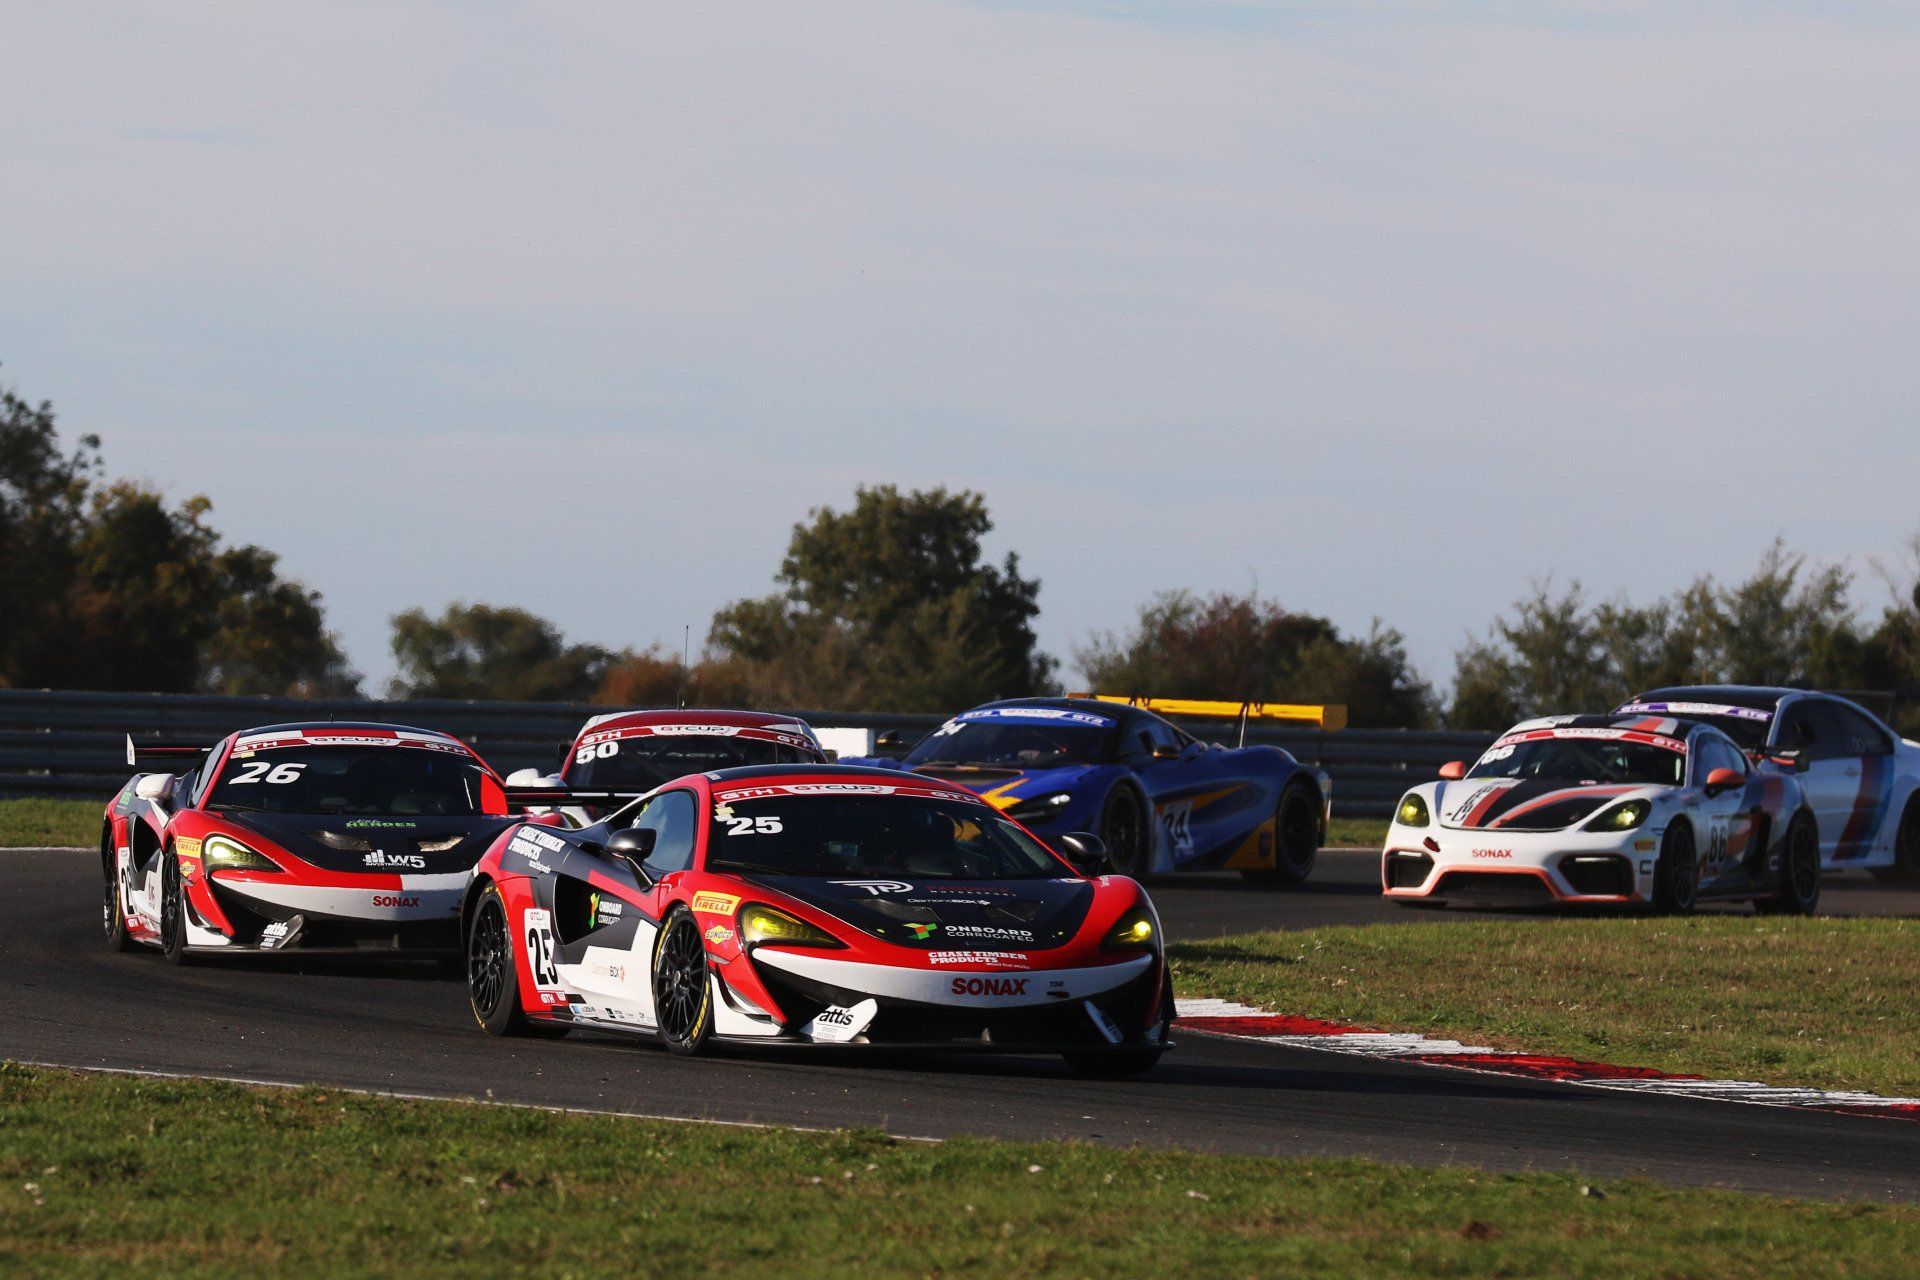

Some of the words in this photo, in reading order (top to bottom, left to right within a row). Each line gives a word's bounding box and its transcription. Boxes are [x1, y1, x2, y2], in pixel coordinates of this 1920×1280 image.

[575, 741, 619, 764] 50
[228, 761, 308, 785] 26
[727, 816, 784, 836] 25
[1472, 849, 1512, 858] SONAX
[373, 895, 419, 908] SONAX
[694, 896, 733, 912] PIRELLI
[945, 925, 1033, 937] ONBOARD
[947, 932, 1035, 942] CORRUGATED
[928, 951, 972, 959] CHASE
[972, 952, 1028, 960] TIMBER
[951, 978, 1027, 996] SONAX
[819, 1008, 854, 1026] attis
